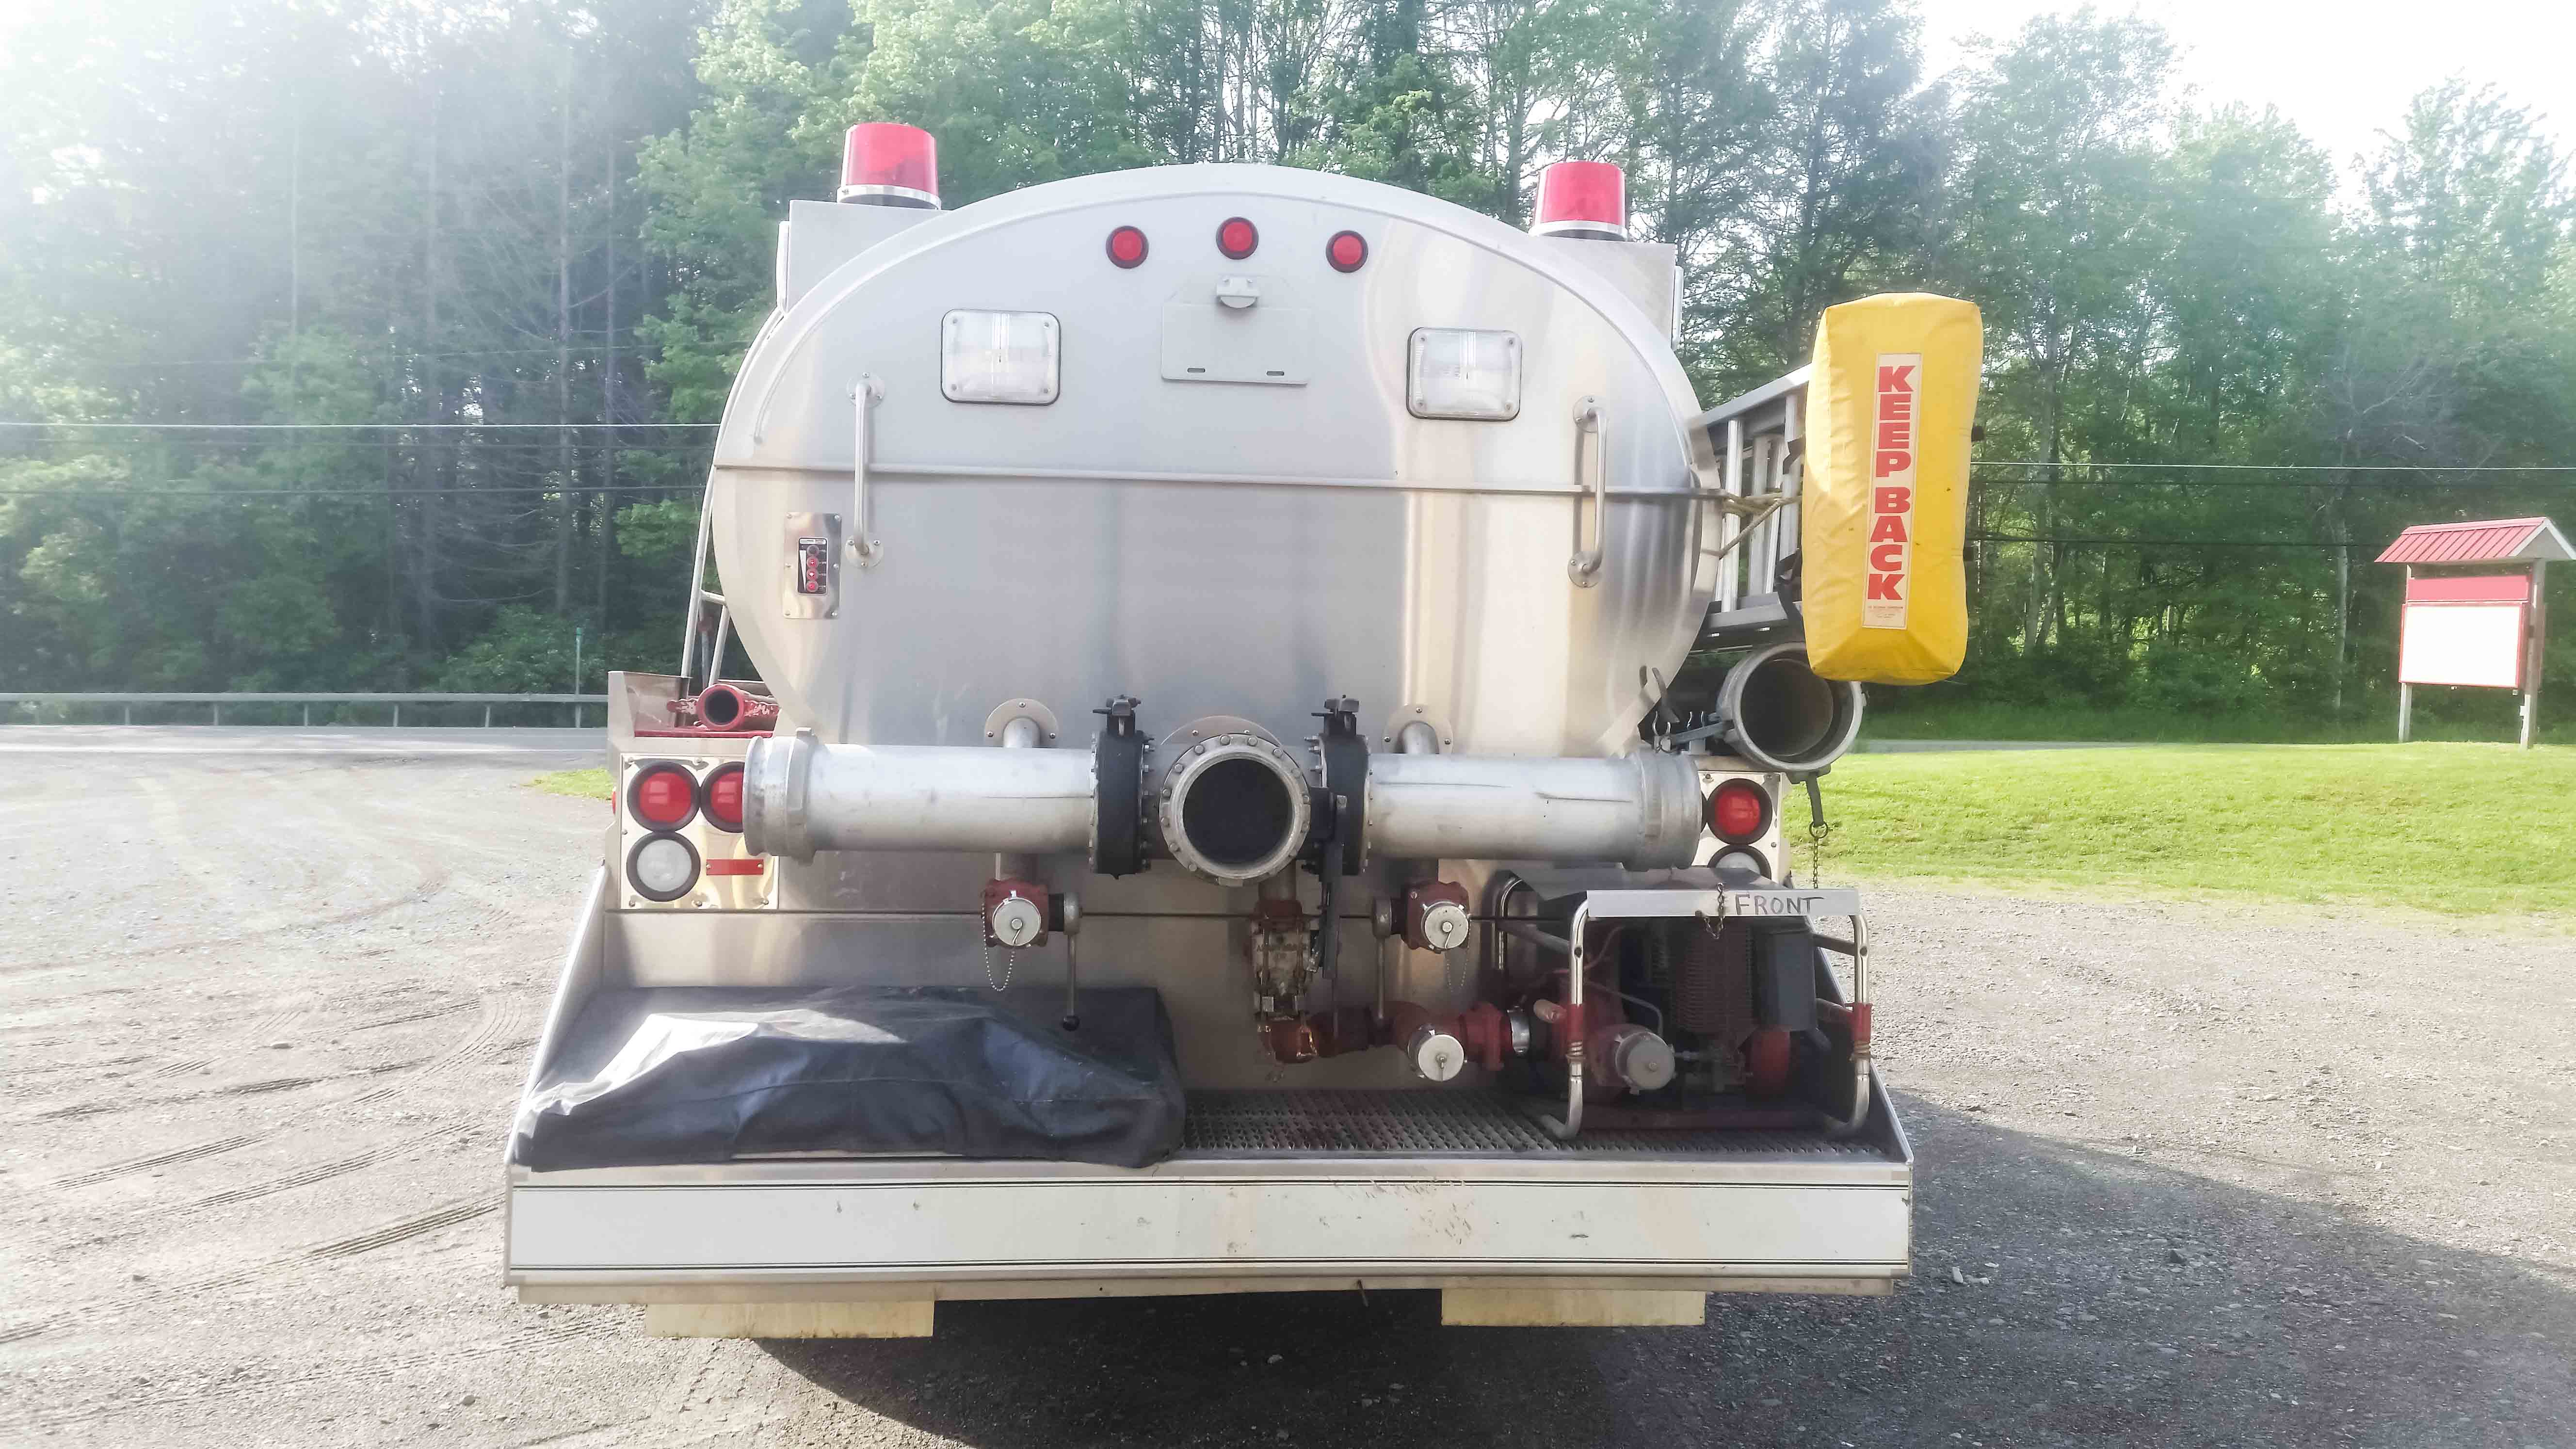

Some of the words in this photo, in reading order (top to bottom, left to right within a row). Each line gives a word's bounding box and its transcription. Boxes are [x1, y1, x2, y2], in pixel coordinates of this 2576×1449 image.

[1875, 365, 1917, 478] KEEP
[1867, 486, 1912, 600] BACK
[1736, 894, 1824, 915] FRONT
